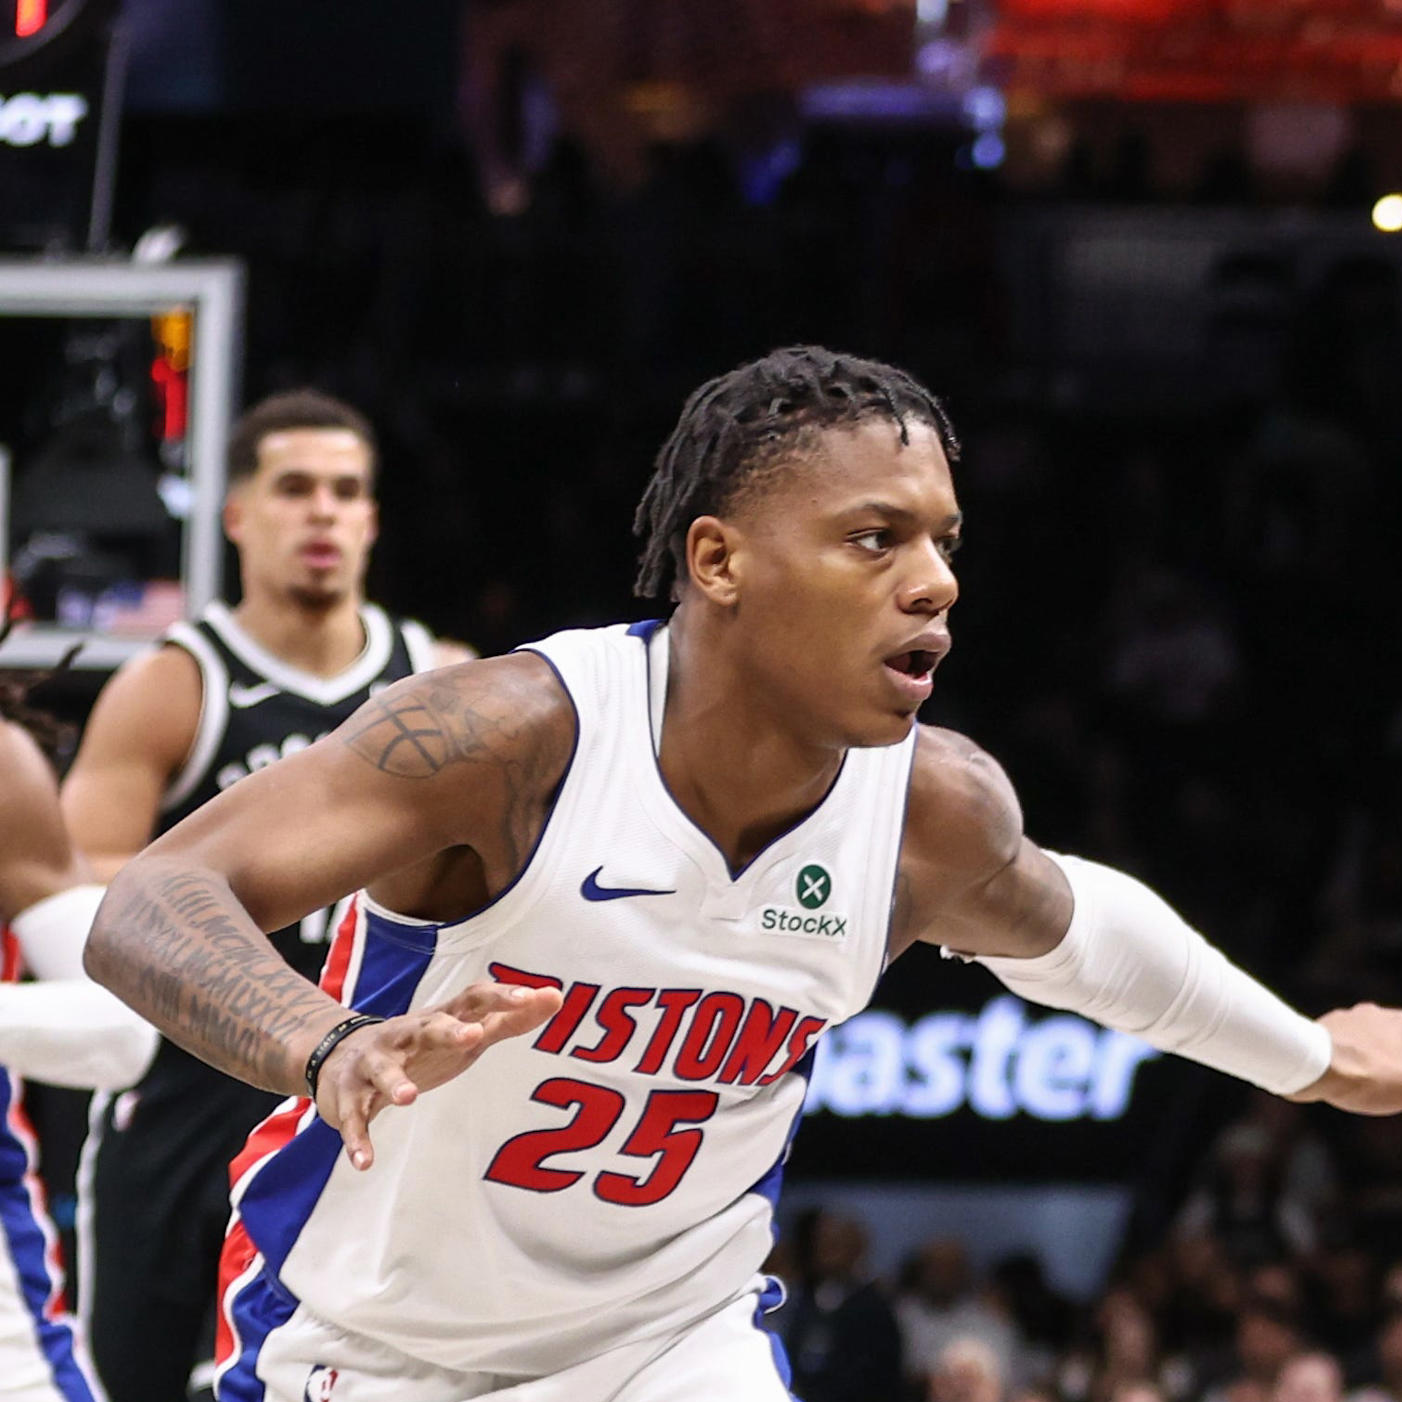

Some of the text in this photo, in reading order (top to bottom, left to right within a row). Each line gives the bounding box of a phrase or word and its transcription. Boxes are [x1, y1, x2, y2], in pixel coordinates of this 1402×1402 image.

[0, 92, 88, 146] OT
[761, 908, 847, 936] StockX
[484, 1077, 720, 1207] 25
